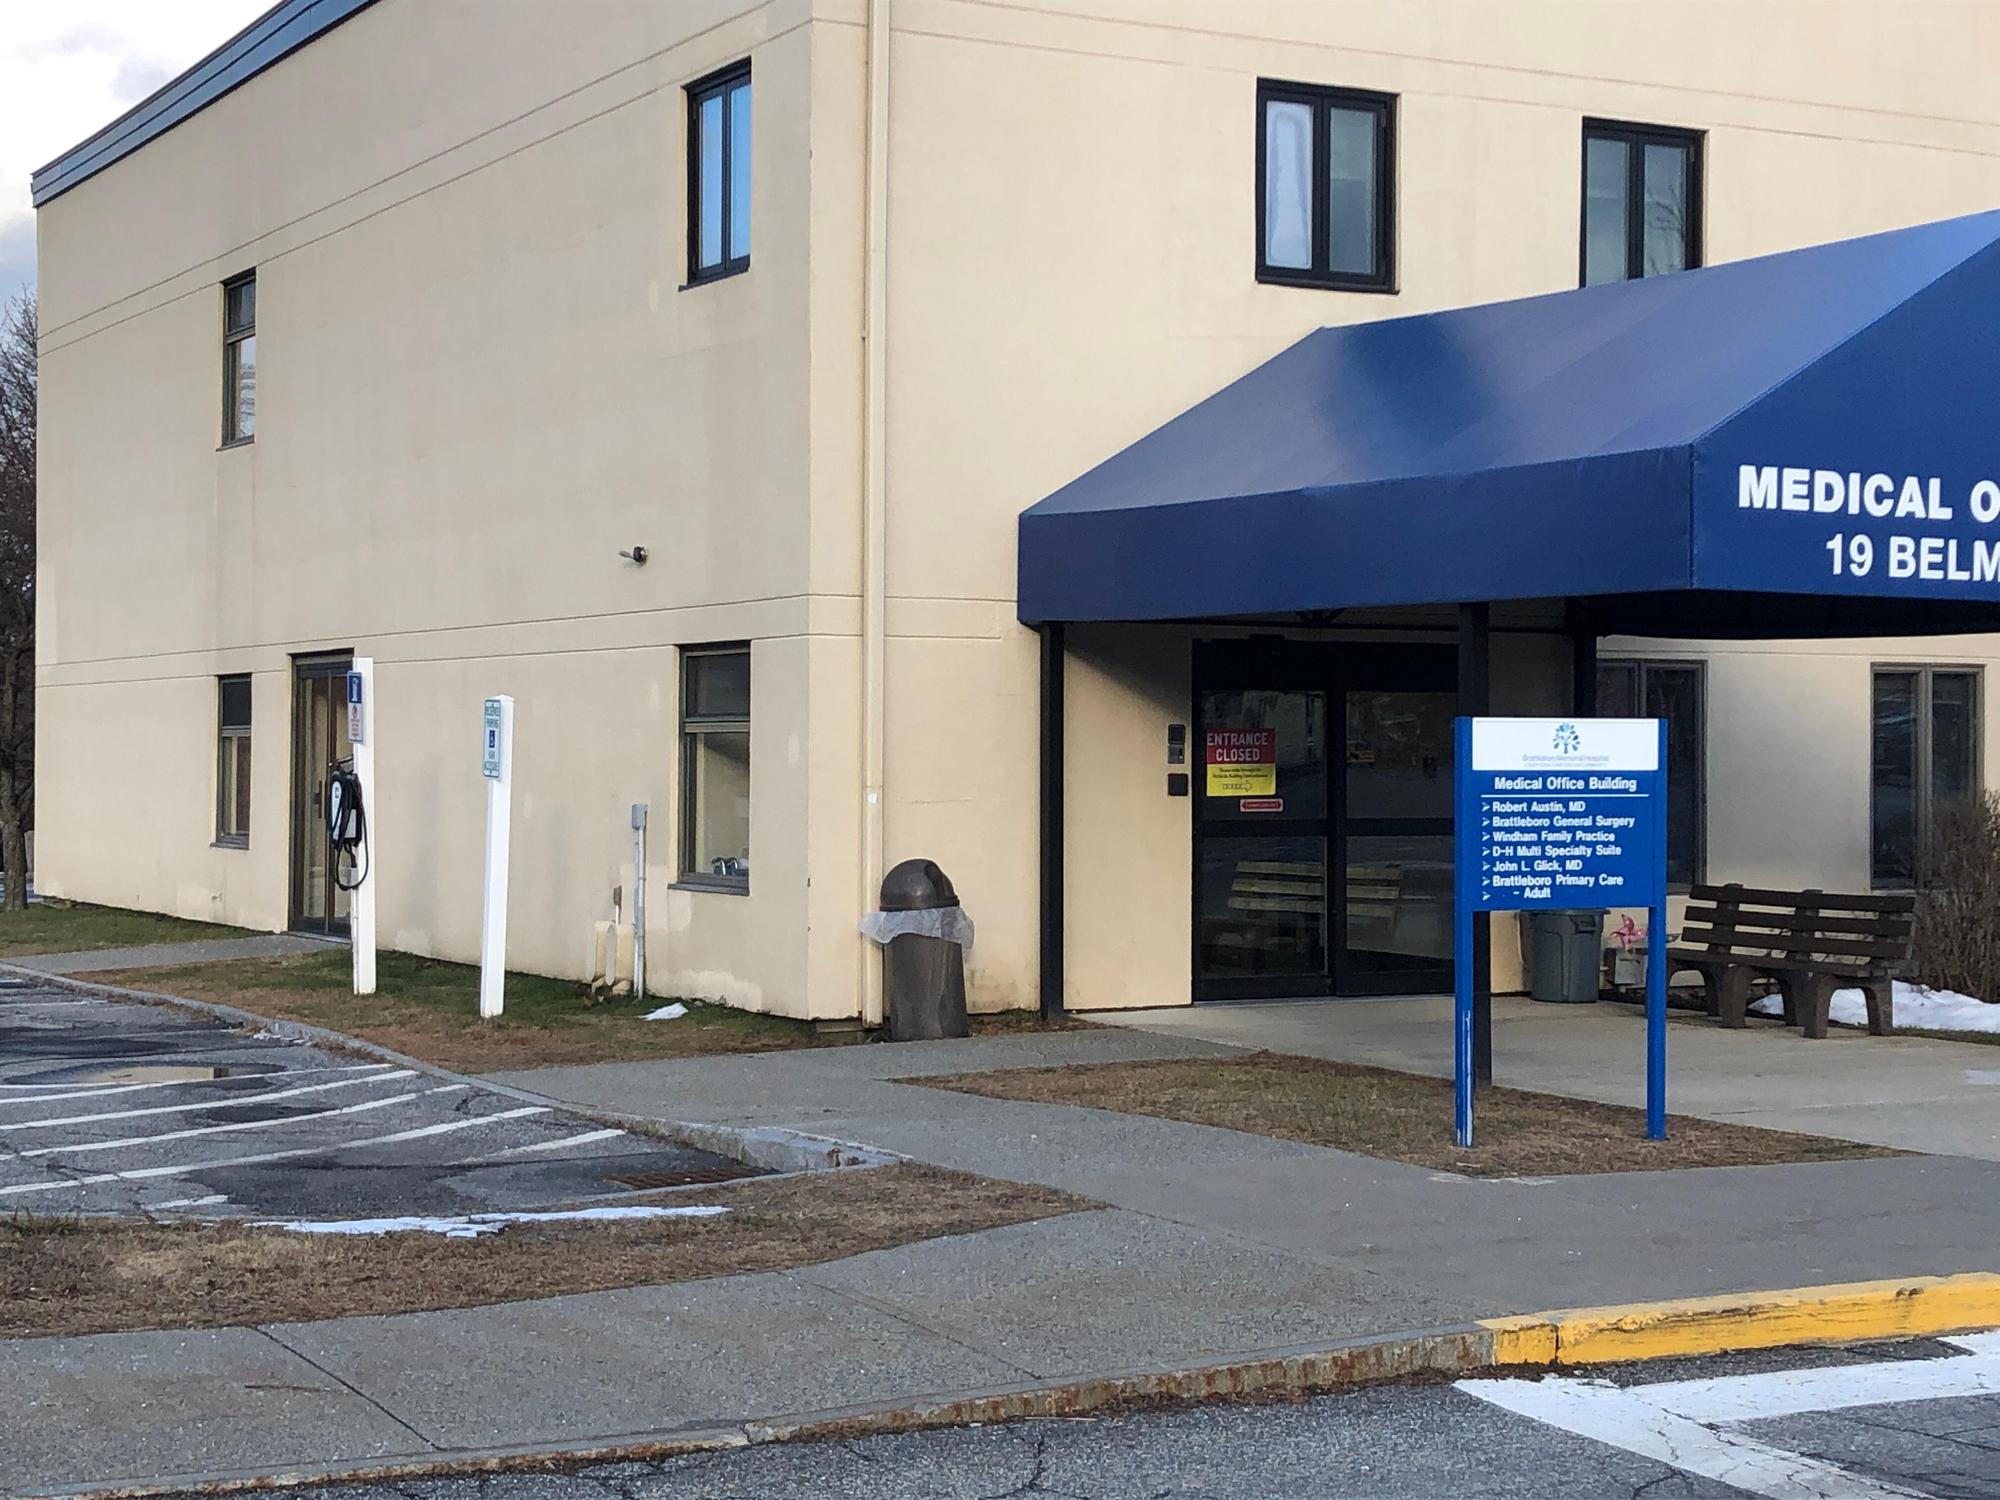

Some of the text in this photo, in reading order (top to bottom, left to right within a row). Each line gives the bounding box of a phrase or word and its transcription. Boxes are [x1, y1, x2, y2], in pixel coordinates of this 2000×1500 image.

[1738, 464, 1953, 520] MEDICAL
[1826, 534, 1873, 576] 19
[1207, 733, 1268, 745] ENTRANCE
[1216, 749, 1260, 761] CLOSED
[1495, 777, 1637, 792] Medical Office Building
[1493, 802, 1585, 813] Robert Austin, MD
[1493, 816, 1635, 828] Brattleboro General Surgery
[1493, 831, 1615, 842] Windham Family Practice
[1493, 845, 1622, 857] D-H Multi Specialty Suite
[1493, 861, 1518, 871] John
[1534, 860, 1562, 872] Glick,
[1566, 860, 1582, 870] MD
[1493, 874, 1623, 887] Brattleboro Primary Care
[1524, 888, 1551, 898] Adult
